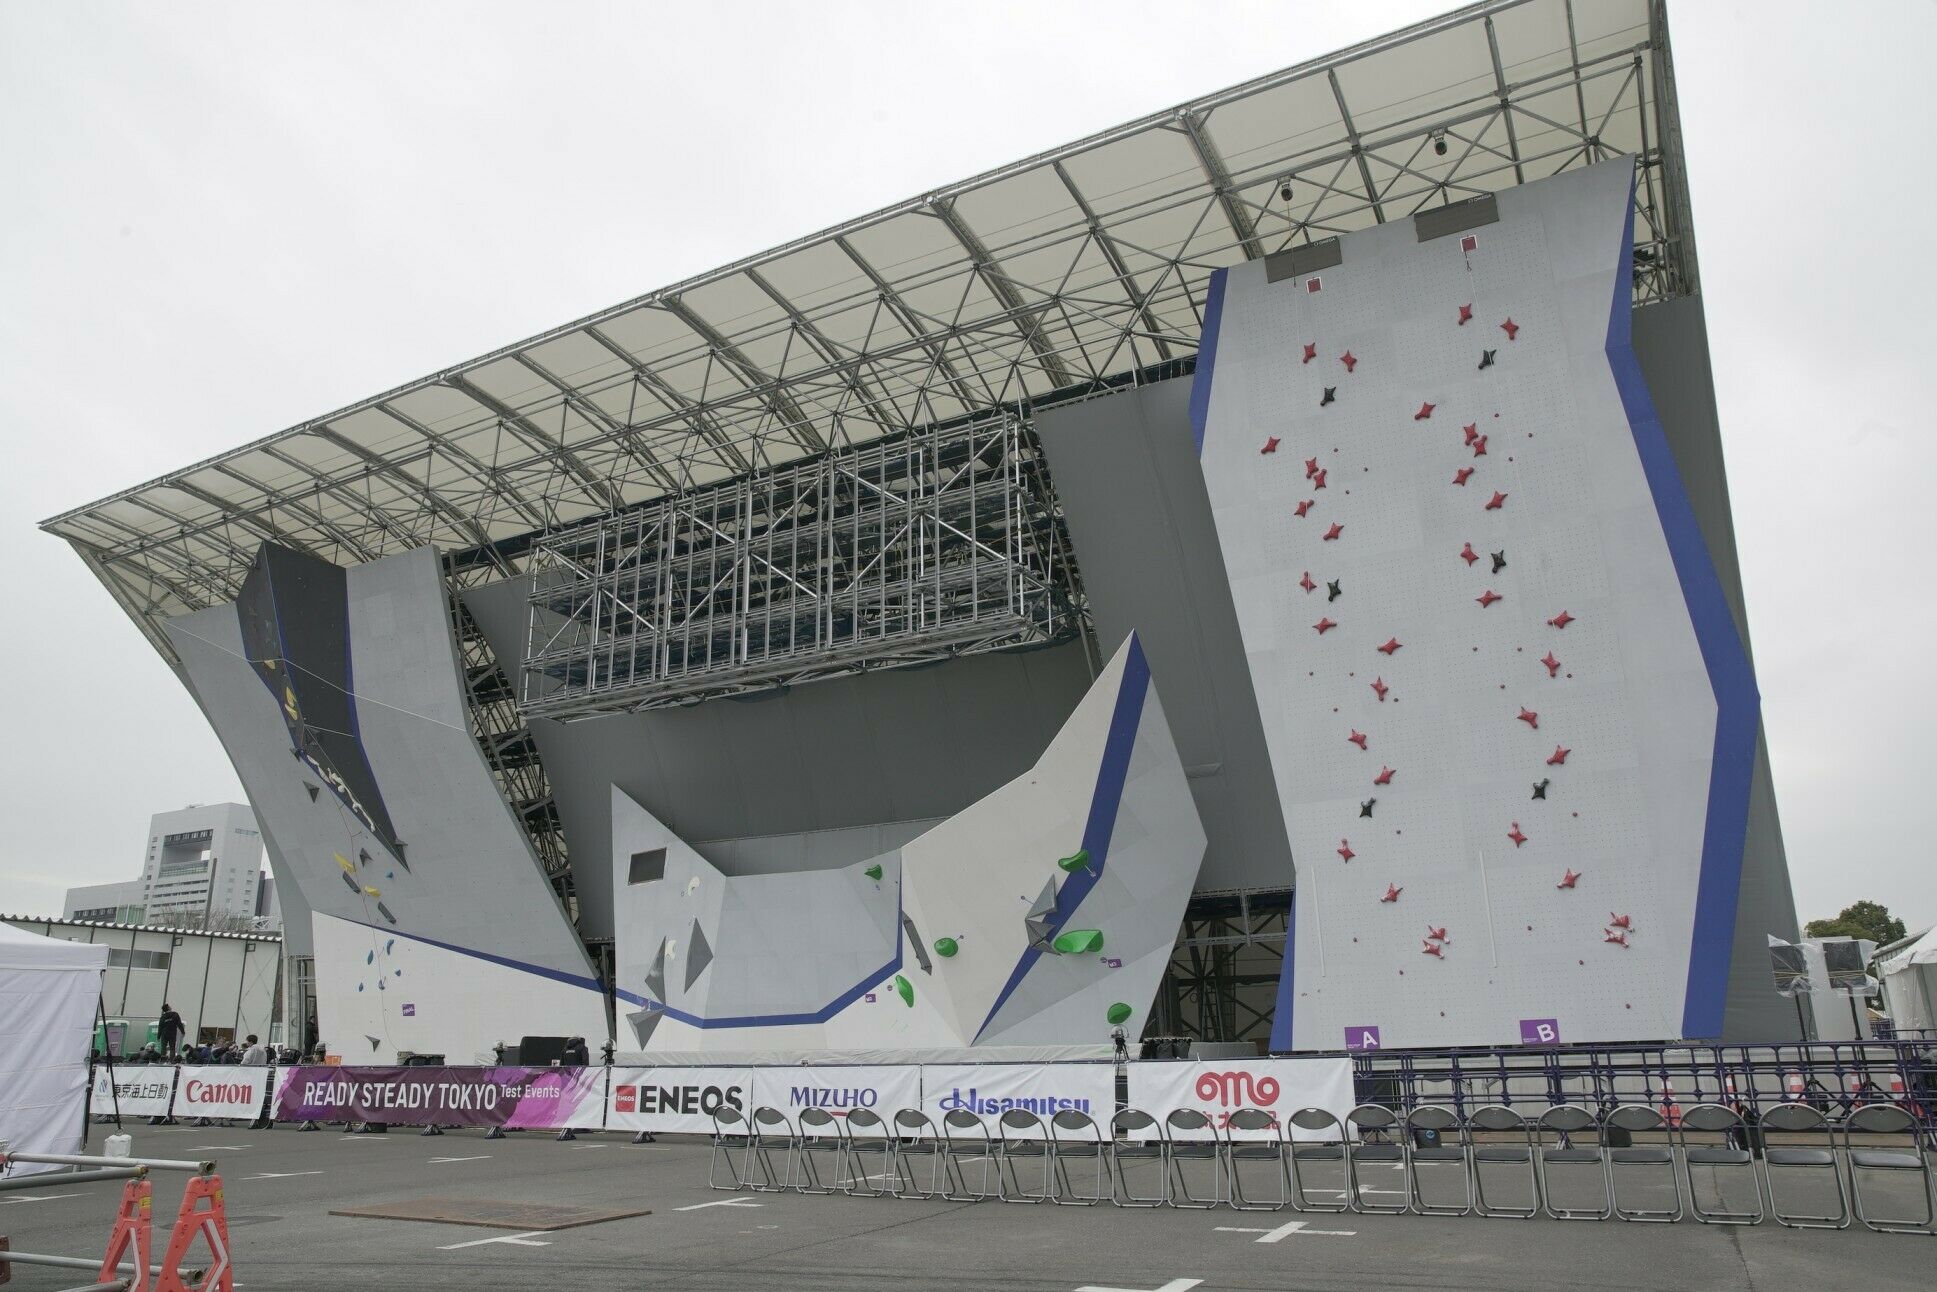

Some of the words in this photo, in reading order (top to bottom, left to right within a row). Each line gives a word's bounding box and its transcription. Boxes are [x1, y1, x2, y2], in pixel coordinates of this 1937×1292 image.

[1363, 1031, 1378, 1049] A
[1536, 1023, 1555, 1043] B
[112, 1083, 168, 1100] 東京海上日動
[186, 1079, 253, 1105] Canon
[303, 1081, 359, 1107] READY
[361, 1082, 434, 1109] STEADY
[438, 1083, 497, 1110] TOKYO
[500, 1084, 522, 1098] Test
[524, 1084, 560, 1099] Events
[639, 1085, 743, 1116] ENEOS
[790, 1086, 878, 1107] MIZUHO
